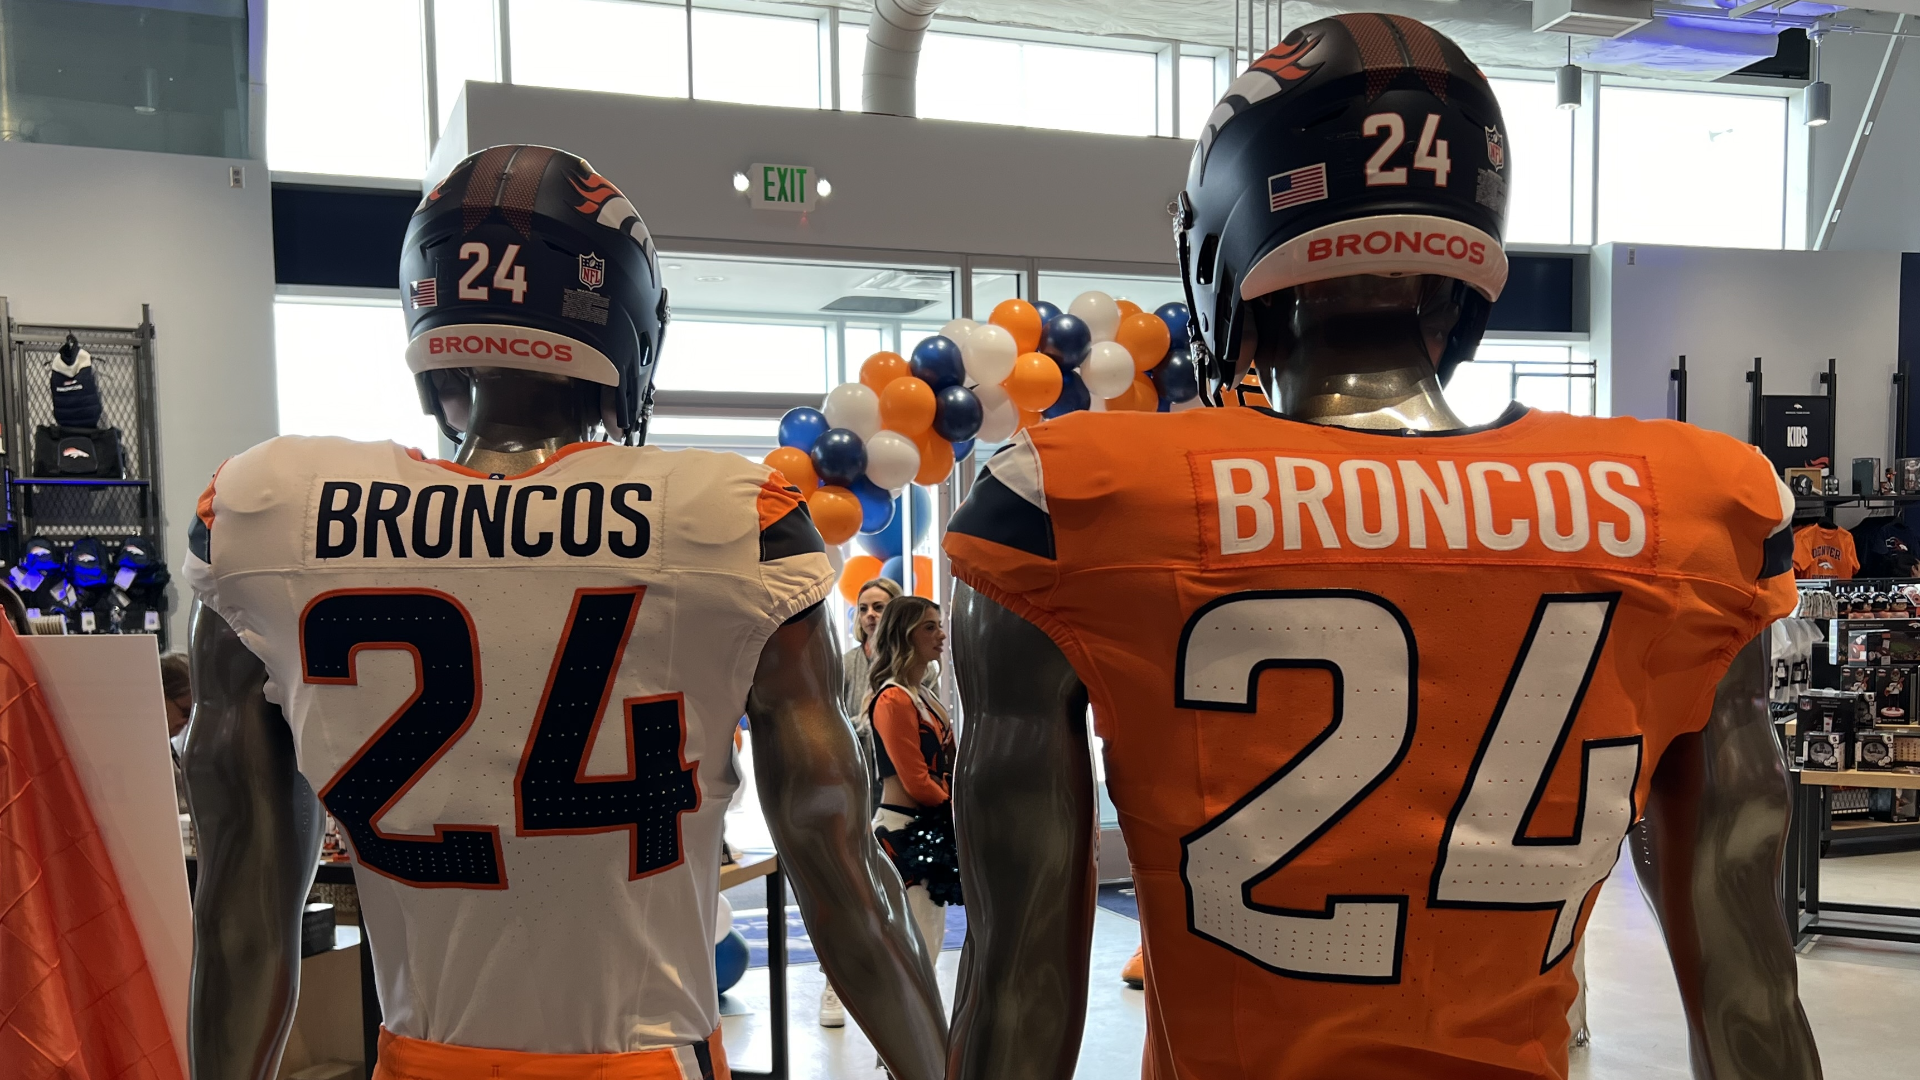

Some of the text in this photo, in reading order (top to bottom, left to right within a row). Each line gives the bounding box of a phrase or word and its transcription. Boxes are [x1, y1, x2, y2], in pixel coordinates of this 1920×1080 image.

[1362, 113, 1452, 188] 24
[763, 166, 807, 203] EXIT
[1307, 229, 1486, 265] BRONCOS
[458, 242, 528, 304] 24
[582, 267, 600, 284] NFL
[429, 336, 573, 362] BRONCOS
[1787, 426, 1808, 448] KIDS
[316, 481, 652, 559] BRONCOS
[1210, 456, 1647, 558] BRONCOS
[1812, 545, 1842, 561] DENVER
[299, 587, 702, 889] 24
[1175, 589, 1642, 984] 24
